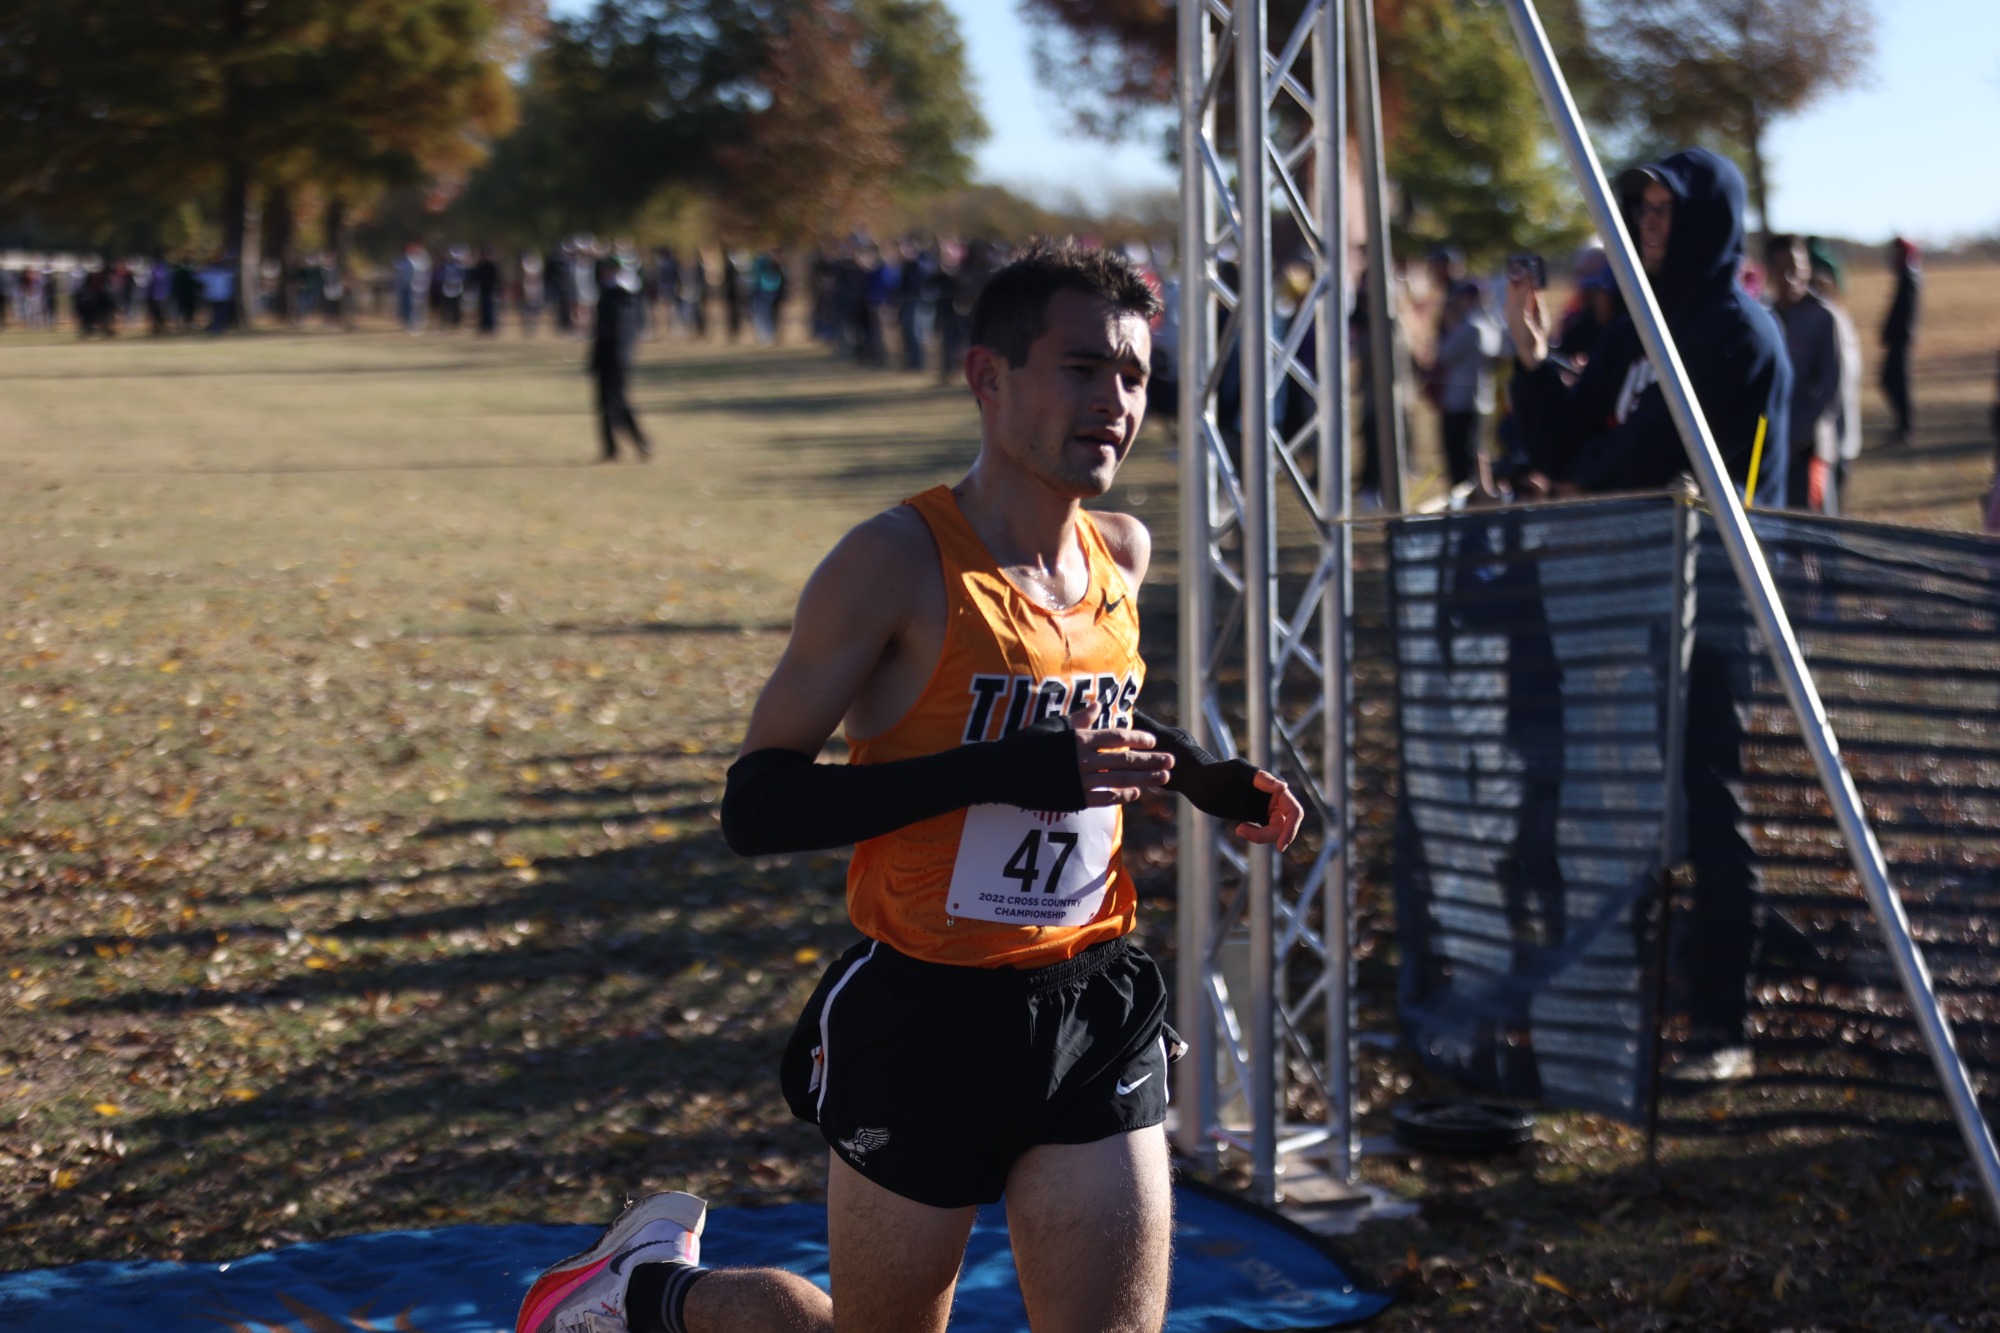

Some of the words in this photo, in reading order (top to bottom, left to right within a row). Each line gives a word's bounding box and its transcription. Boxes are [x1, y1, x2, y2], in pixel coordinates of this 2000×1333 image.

[1002, 829, 1079, 894] 47
[978, 892, 1005, 904] 2022
[1007, 896, 1039, 907] CROSS
[1041, 898, 1082, 908] COUNTRY
[994, 907, 1067, 920] CHAMPIONSHIP
